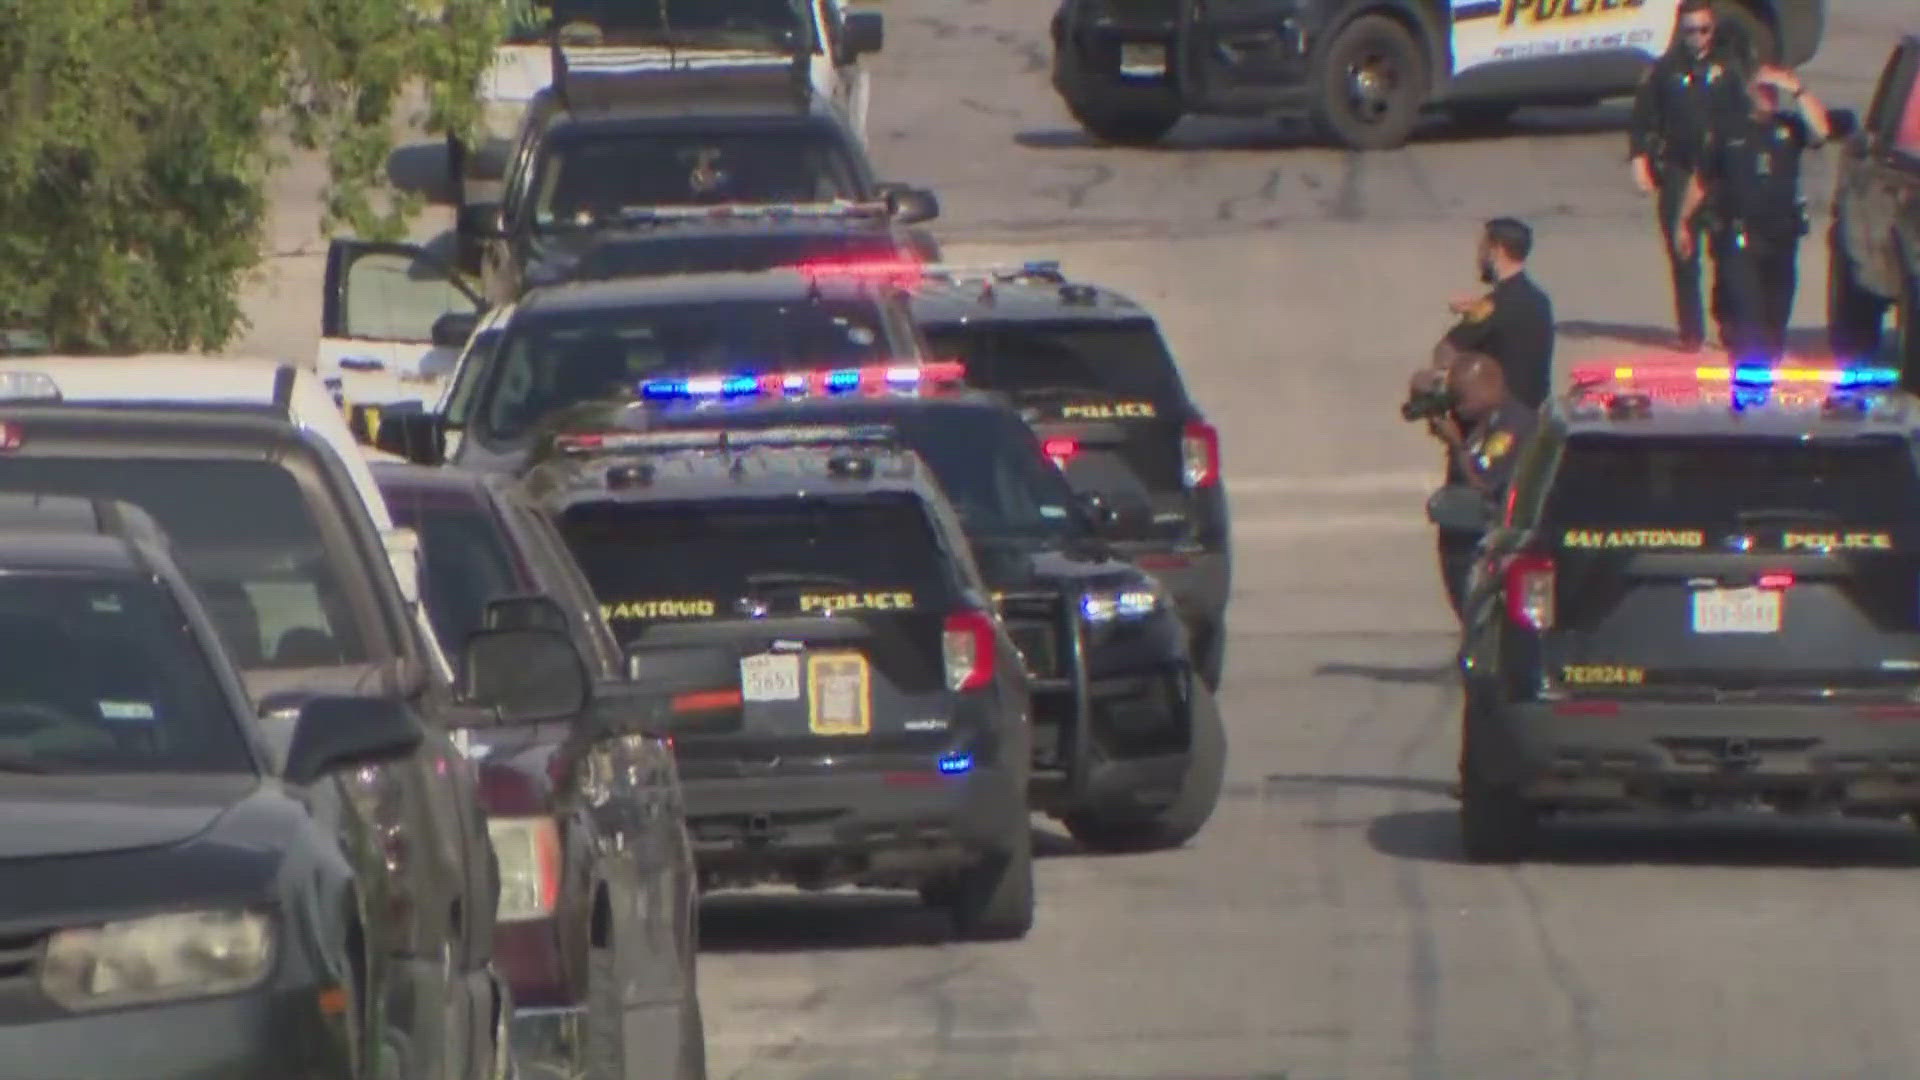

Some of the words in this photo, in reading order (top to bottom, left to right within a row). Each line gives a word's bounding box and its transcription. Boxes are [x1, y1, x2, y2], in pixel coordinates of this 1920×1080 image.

[1062, 402, 1156, 418] POLICE
[1604, 529, 1704, 548] ANTONIO
[1783, 532, 1892, 548] POLICE
[614, 600, 715, 618] ANTONIO
[800, 592, 914, 611] POLICE
